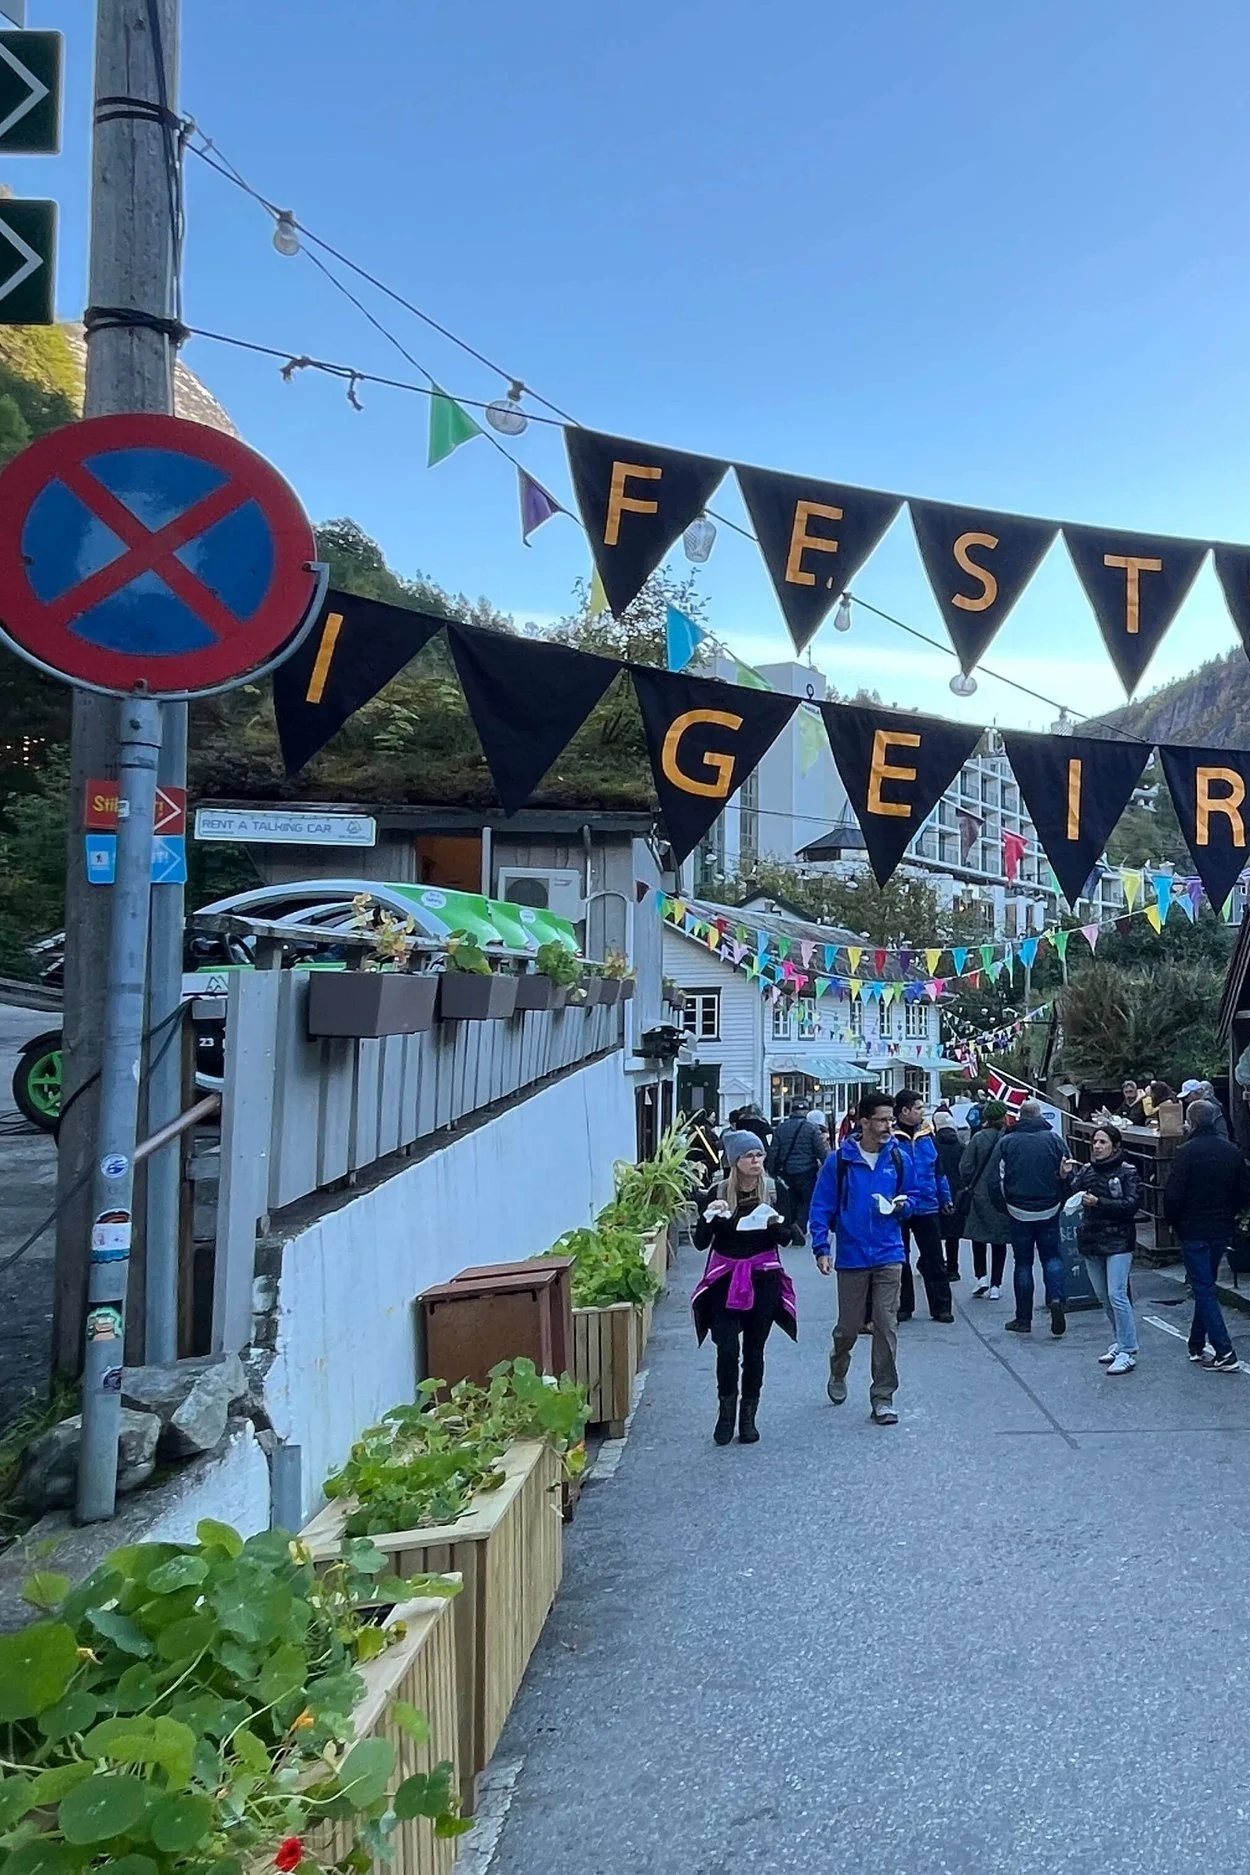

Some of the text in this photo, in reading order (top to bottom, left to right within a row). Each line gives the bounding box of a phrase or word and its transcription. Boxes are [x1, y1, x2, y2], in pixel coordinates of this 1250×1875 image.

[306, 612, 344, 704] I
[202, 819, 332, 834] RENT A TALKING CAR
[199, 1037, 215, 1047] 23
